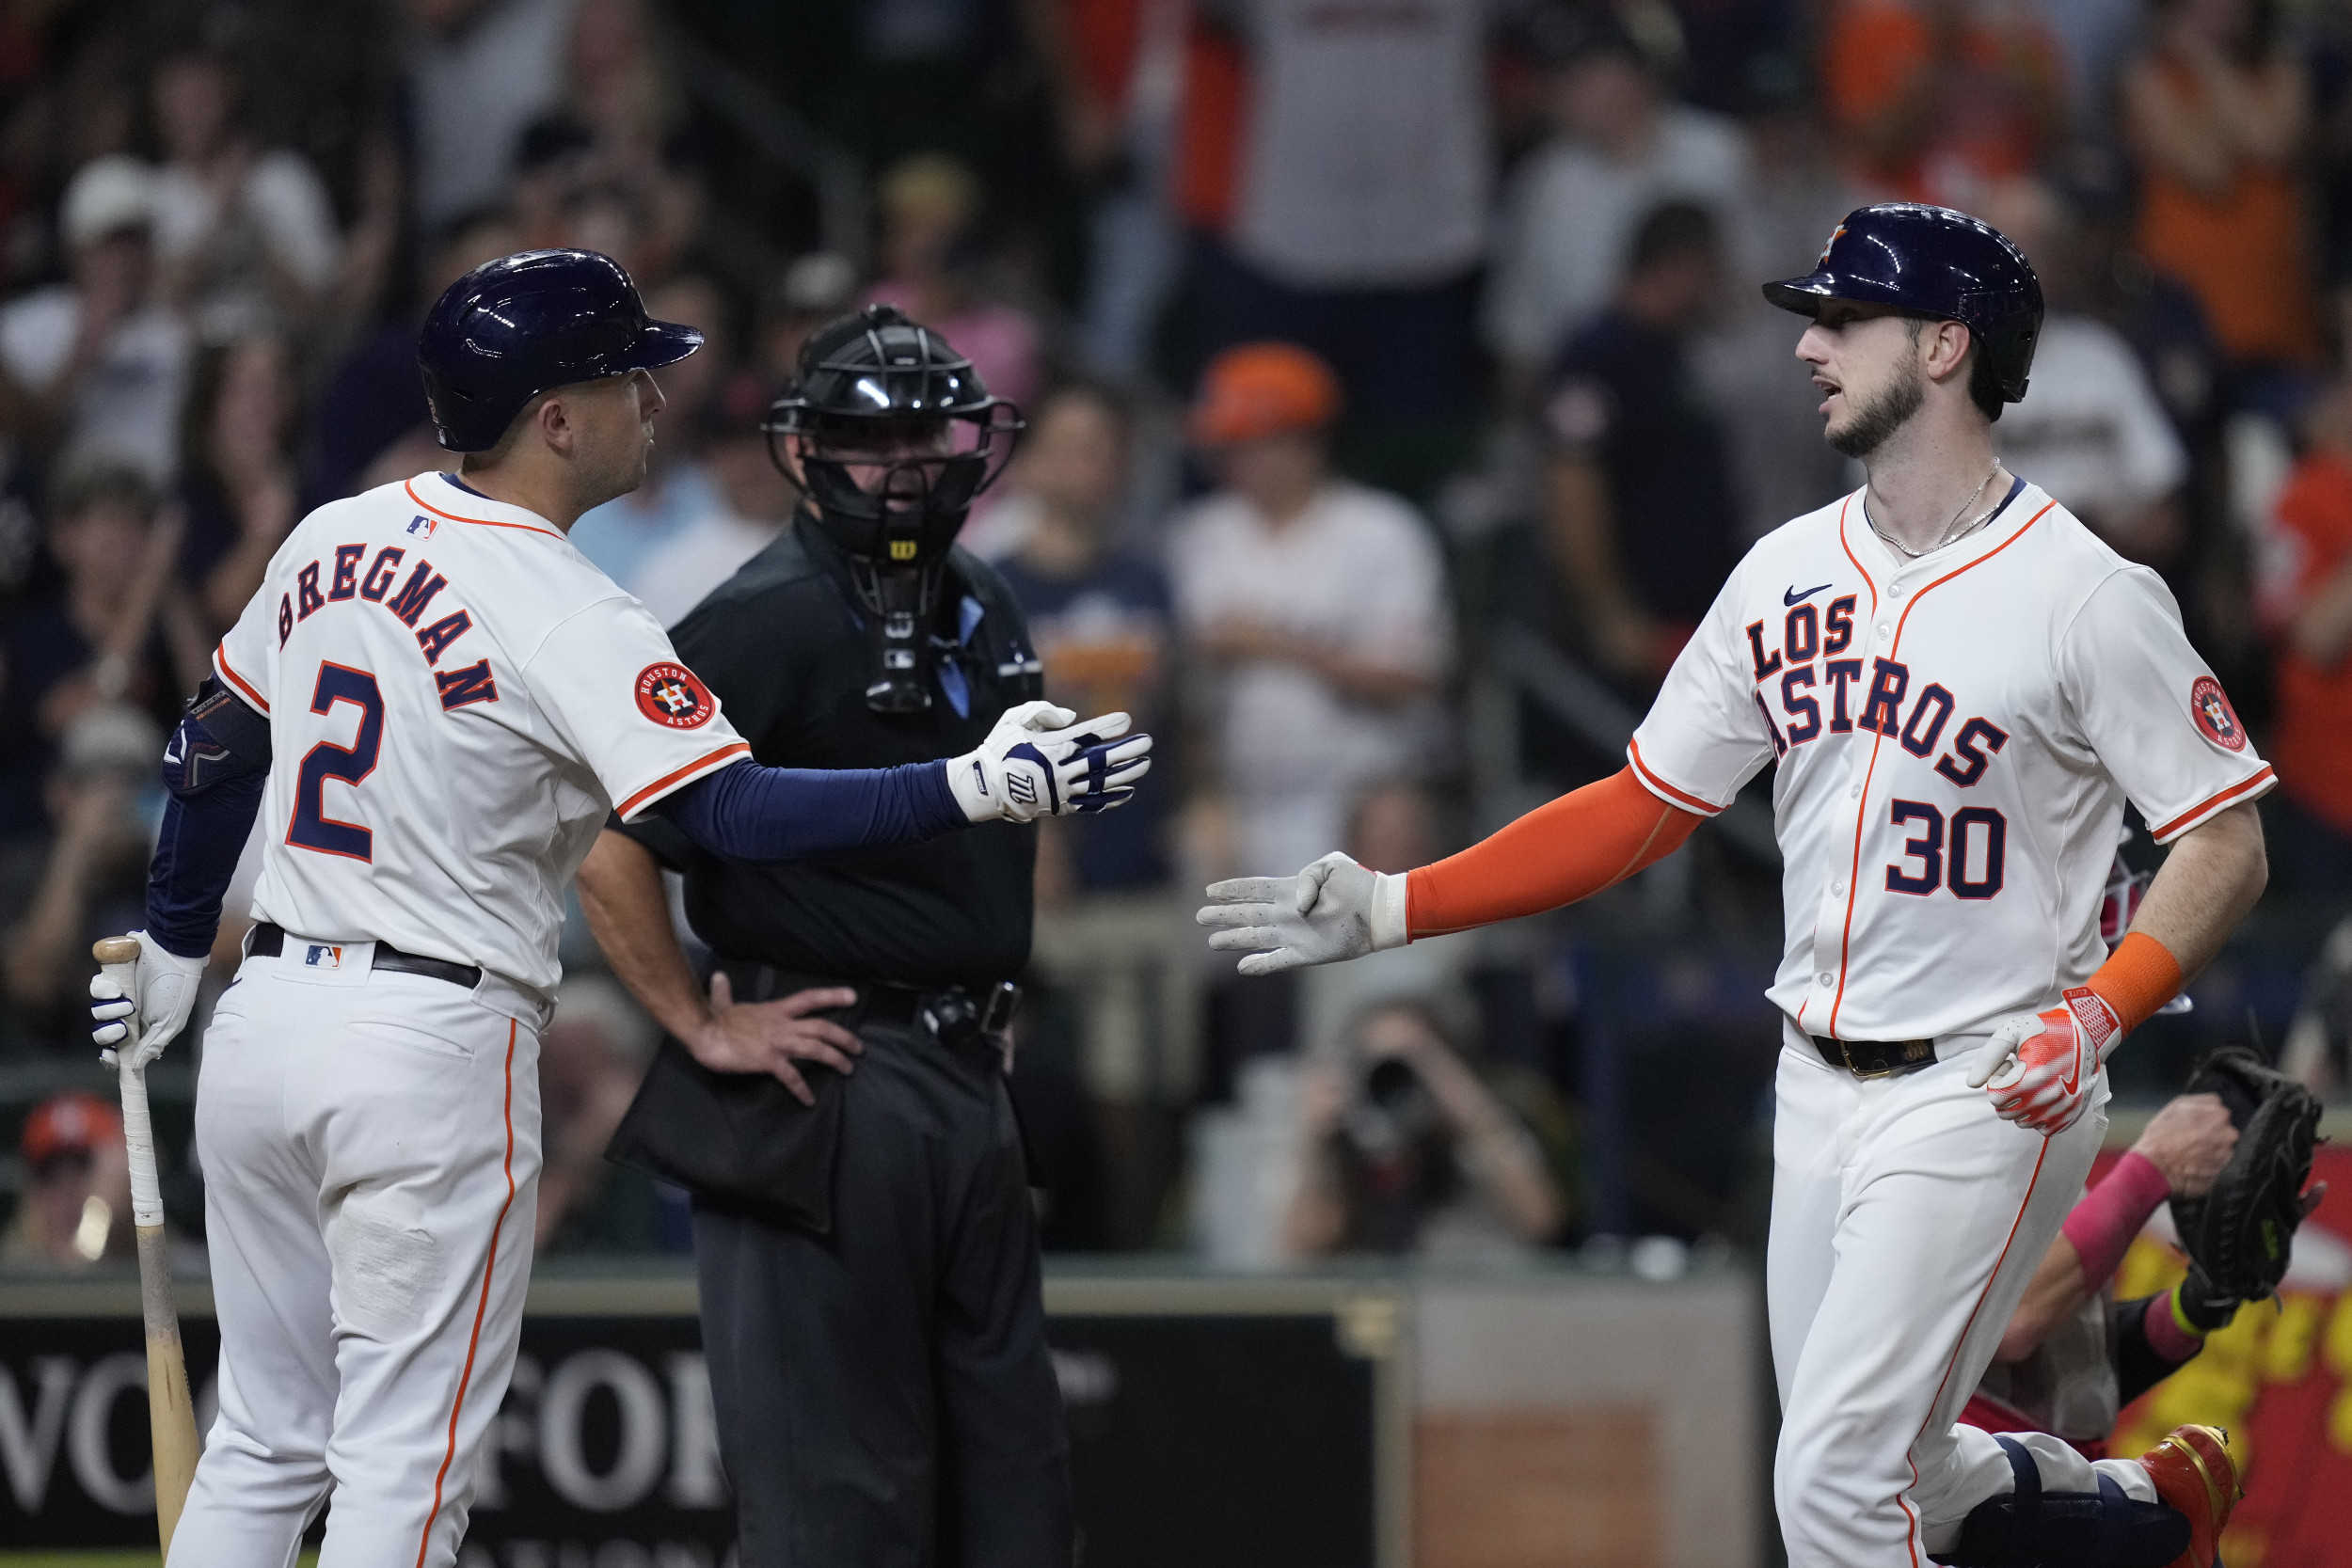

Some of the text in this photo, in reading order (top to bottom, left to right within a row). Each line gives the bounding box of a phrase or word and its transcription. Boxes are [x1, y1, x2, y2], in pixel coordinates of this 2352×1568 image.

[278, 543, 500, 712] BREGMAN
[1746, 594, 1857, 684] LOS
[641, 667, 688, 695] HOUSTON
[667, 705, 709, 726] ASTROS
[1755, 655, 2010, 789] ASTROS
[2194, 682, 2221, 708] HOUSTON
[285, 660, 385, 864] 2
[2217, 727, 2241, 747] ASTROS
[1884, 798, 2008, 900] 30
